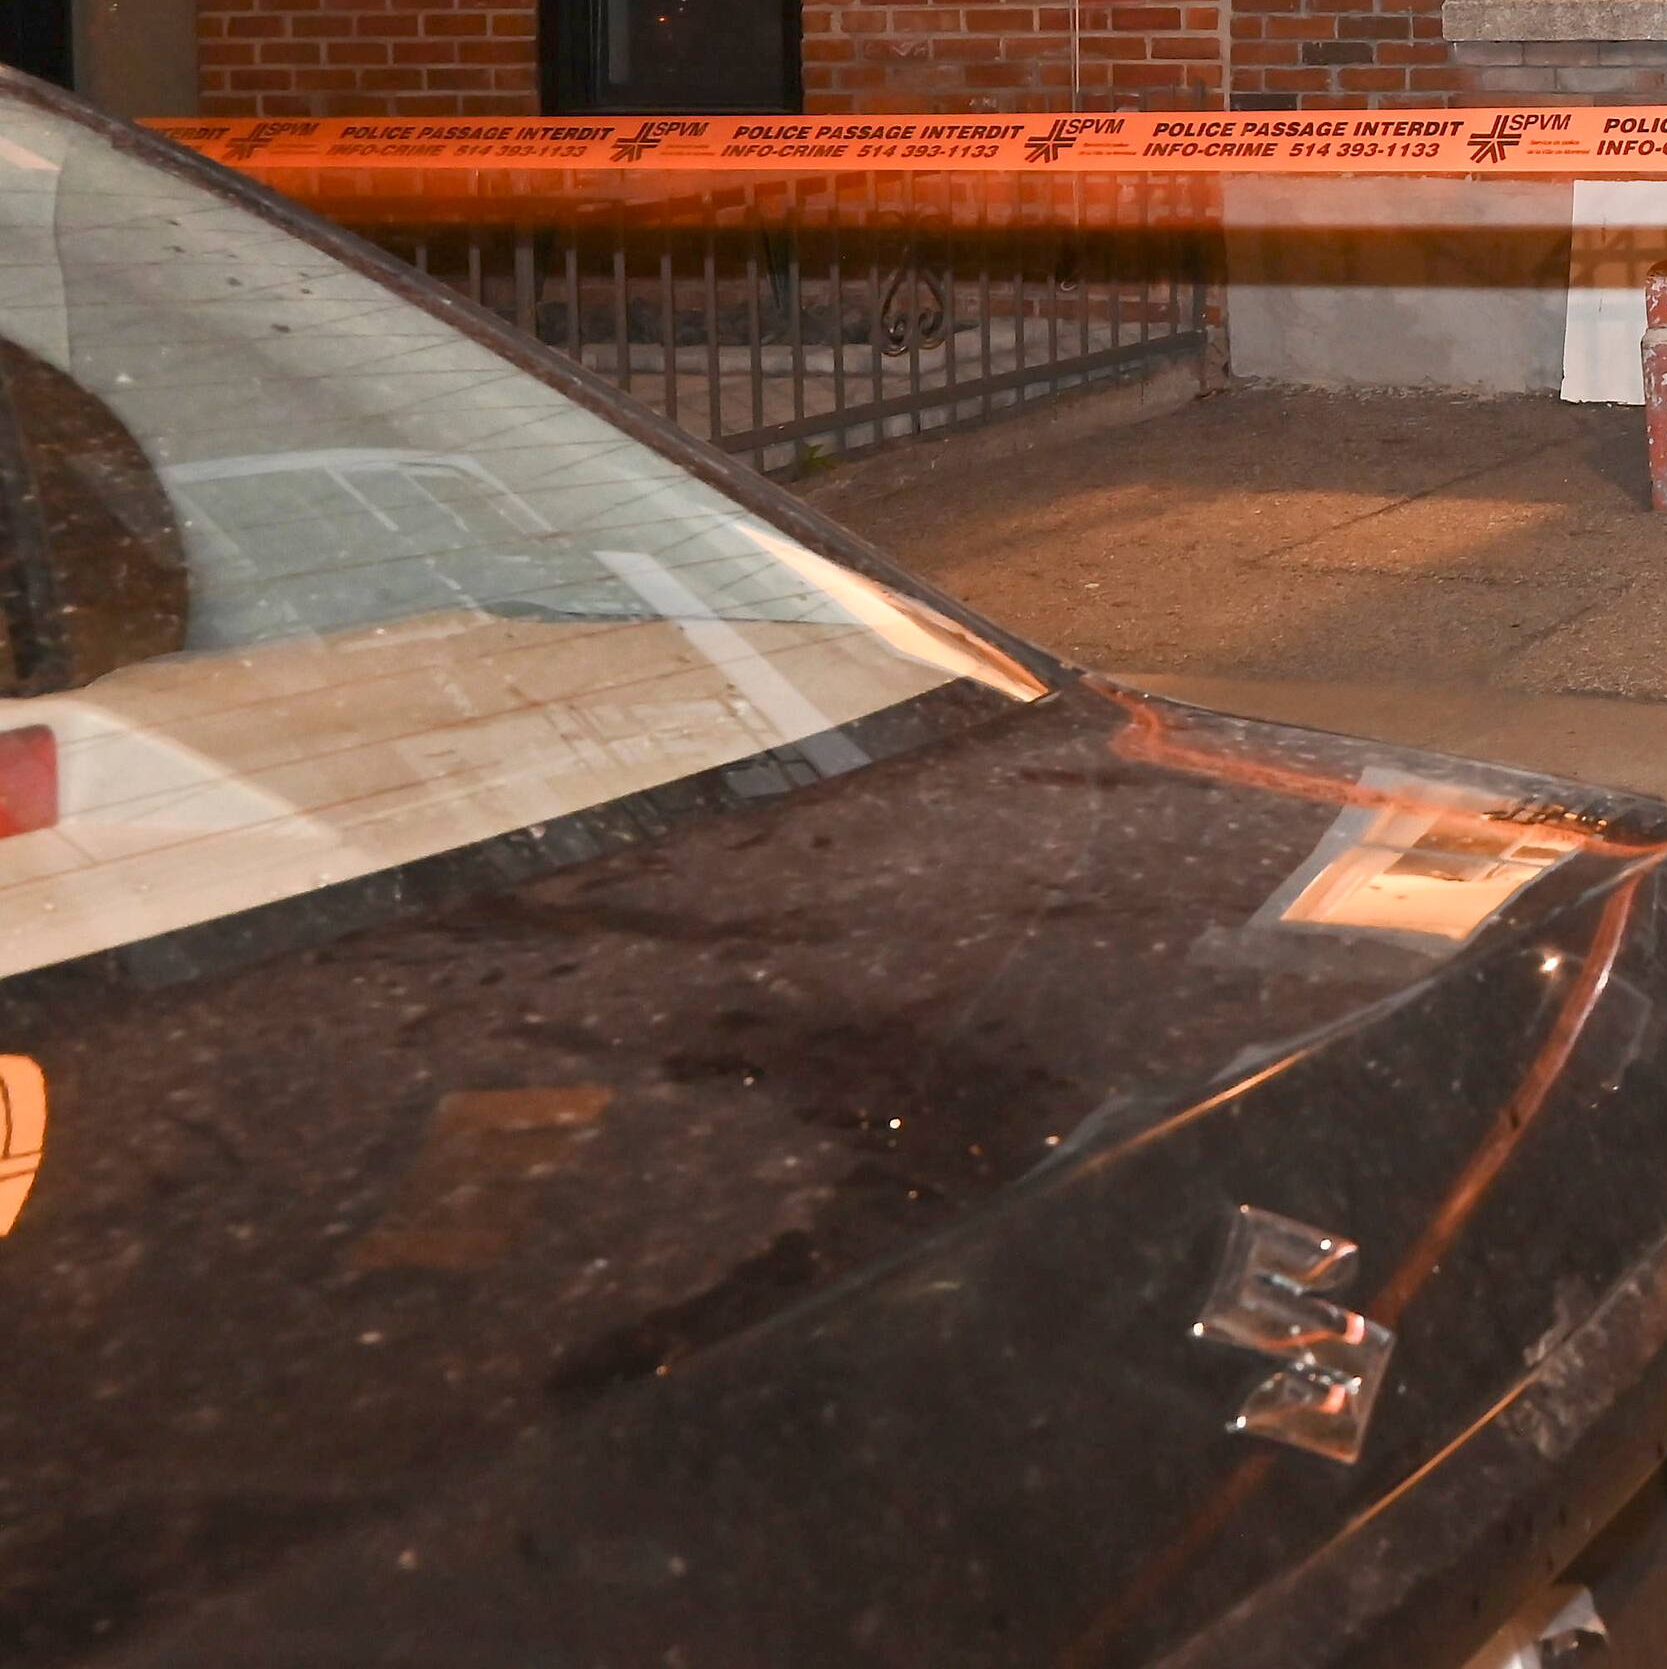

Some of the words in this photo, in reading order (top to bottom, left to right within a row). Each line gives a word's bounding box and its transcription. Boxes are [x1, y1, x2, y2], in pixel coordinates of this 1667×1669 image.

[655, 122, 708, 136] SPVM
[1067, 119, 1124, 134] SPVM
[1509, 114, 1571, 130] SPVM
[268, 123, 319, 136] SPVM
[341, 127, 414, 139] POLICE
[418, 127, 512, 139] PASSAGE
[515, 128, 615, 140] INTERDIT
[733, 126, 811, 139] POLICE
[815, 126, 916, 139] PASSAGE
[921, 126, 1024, 139] INTERDIT
[1153, 123, 1236, 137] POLICE
[1241, 122, 1348, 136] PASSAGE
[1354, 122, 1464, 136] INTERDIT
[721, 145, 848, 157] INFO-CRIME
[857, 145, 897, 157] 514
[901, 145, 999, 157] 393-1133
[1143, 143, 1278, 156] INFO-CRIME
[1290, 143, 1330, 156] 514
[1337, 143, 1439, 157] 393-1133
